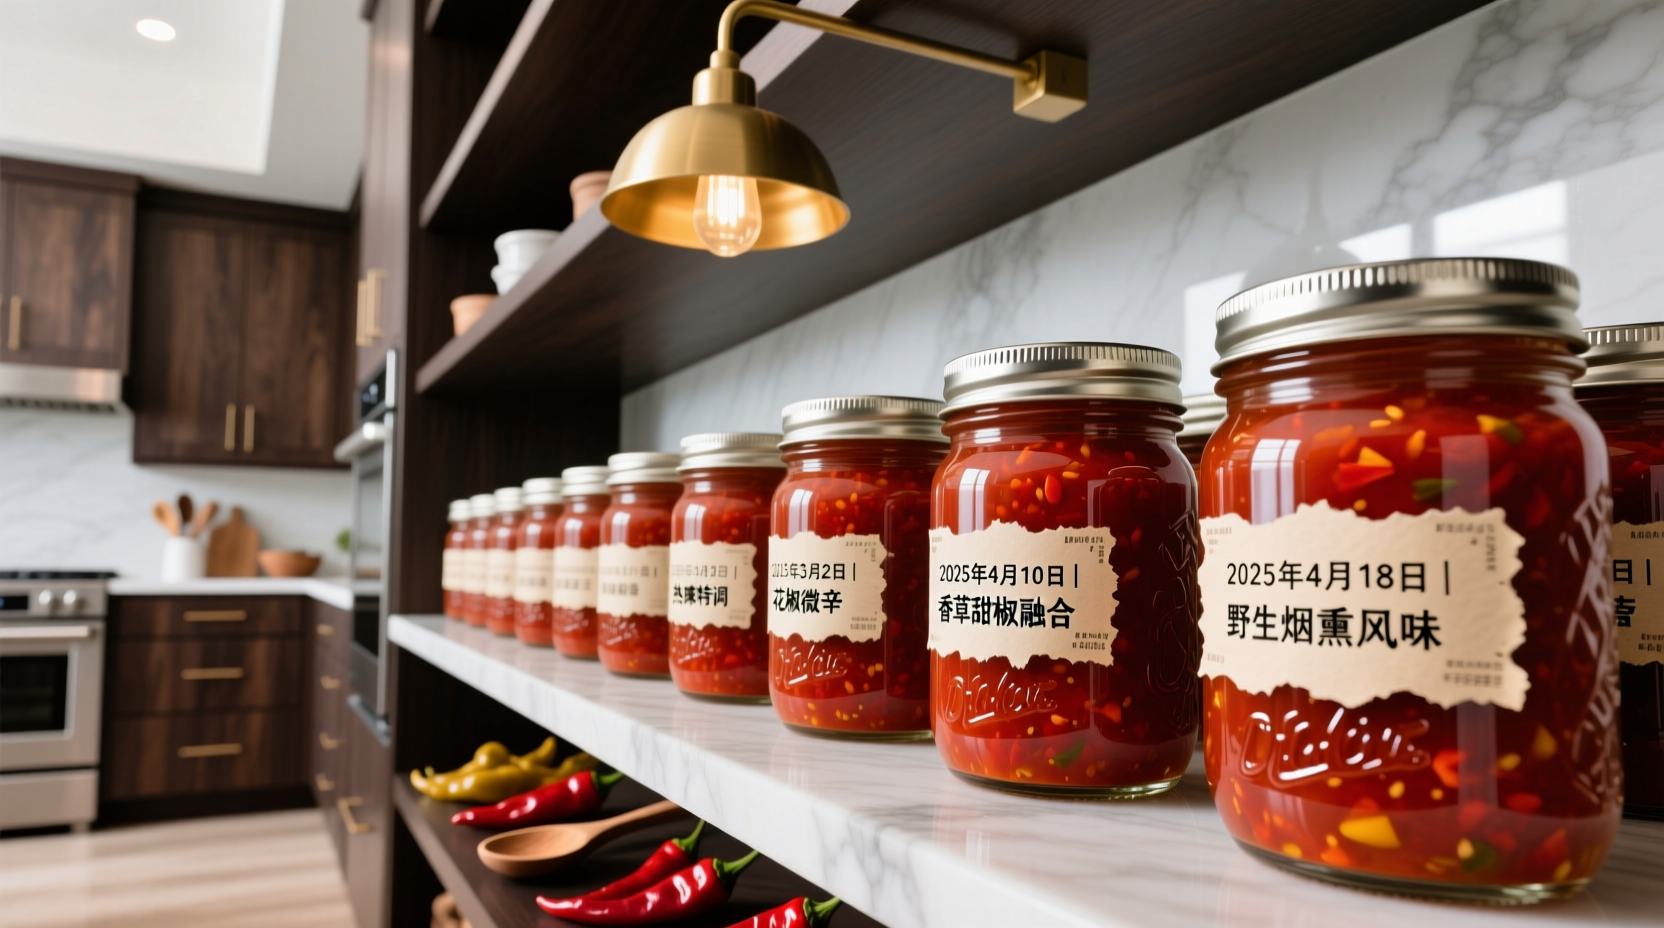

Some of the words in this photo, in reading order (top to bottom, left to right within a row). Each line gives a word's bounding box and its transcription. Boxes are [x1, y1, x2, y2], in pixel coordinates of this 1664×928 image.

[773, 587, 843, 614] 花椒微辛
[938, 594, 1075, 629] 香草甜椒融合
[1226, 603, 1442, 650] 野生烟熏风味
